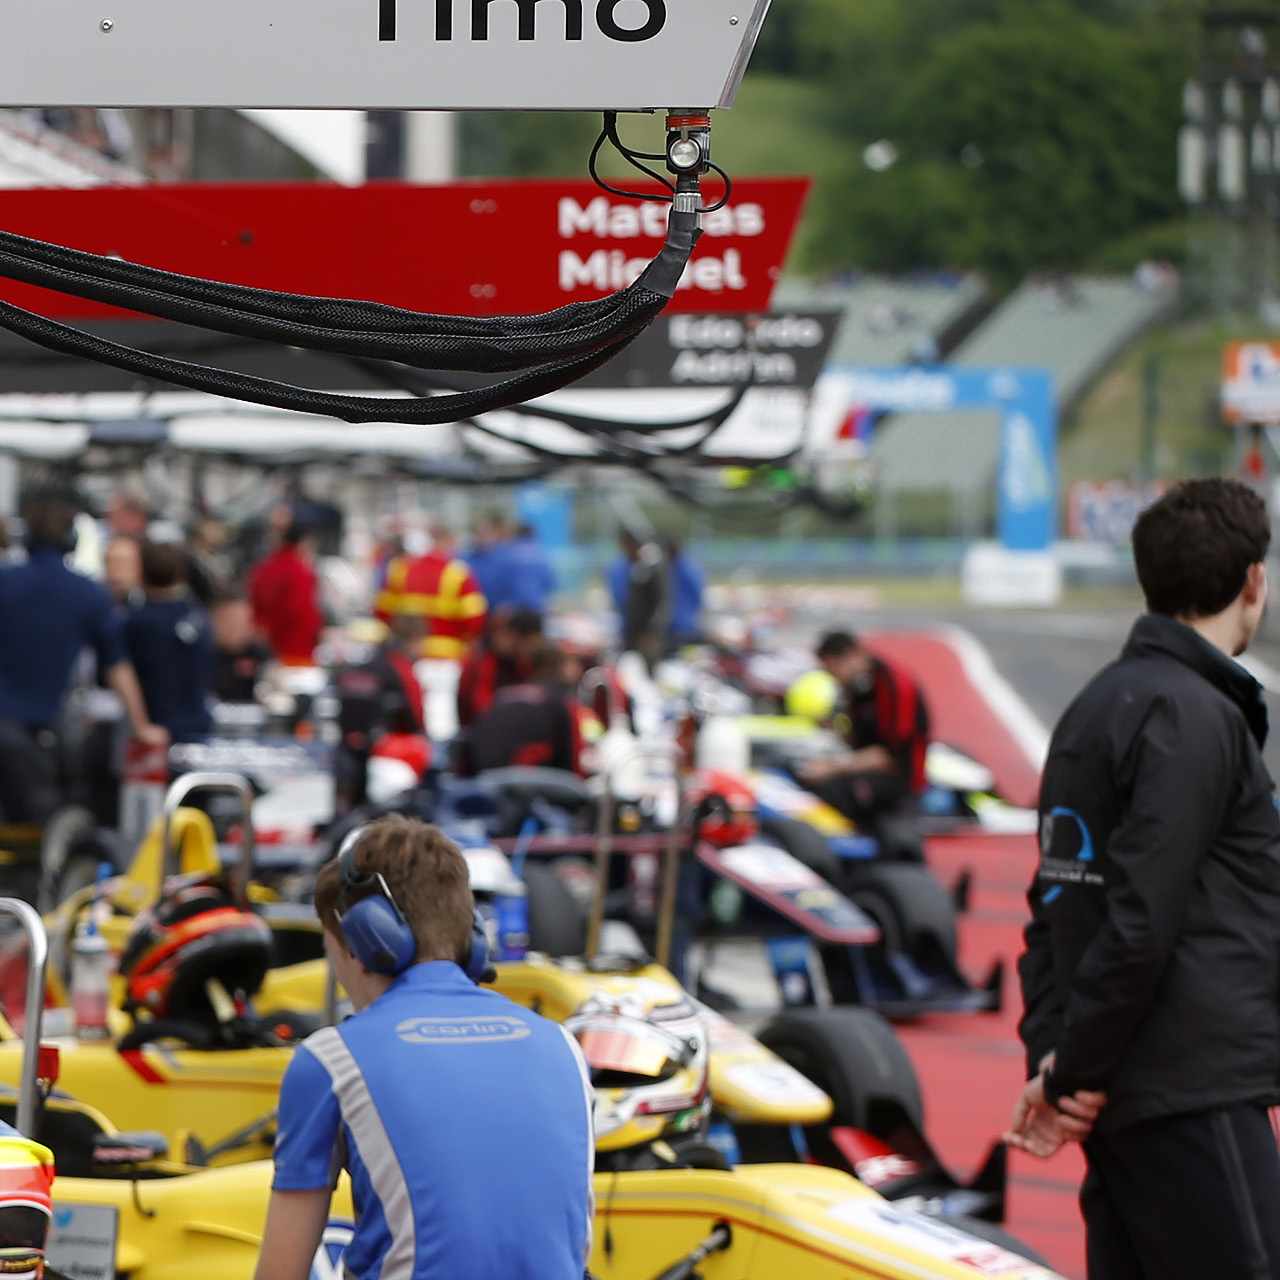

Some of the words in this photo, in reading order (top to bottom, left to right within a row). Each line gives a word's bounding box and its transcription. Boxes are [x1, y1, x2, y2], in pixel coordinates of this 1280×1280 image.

[557, 196, 764, 239] Matas
[557, 248, 747, 292] Miel
[420, 1019, 509, 1038] carlin
